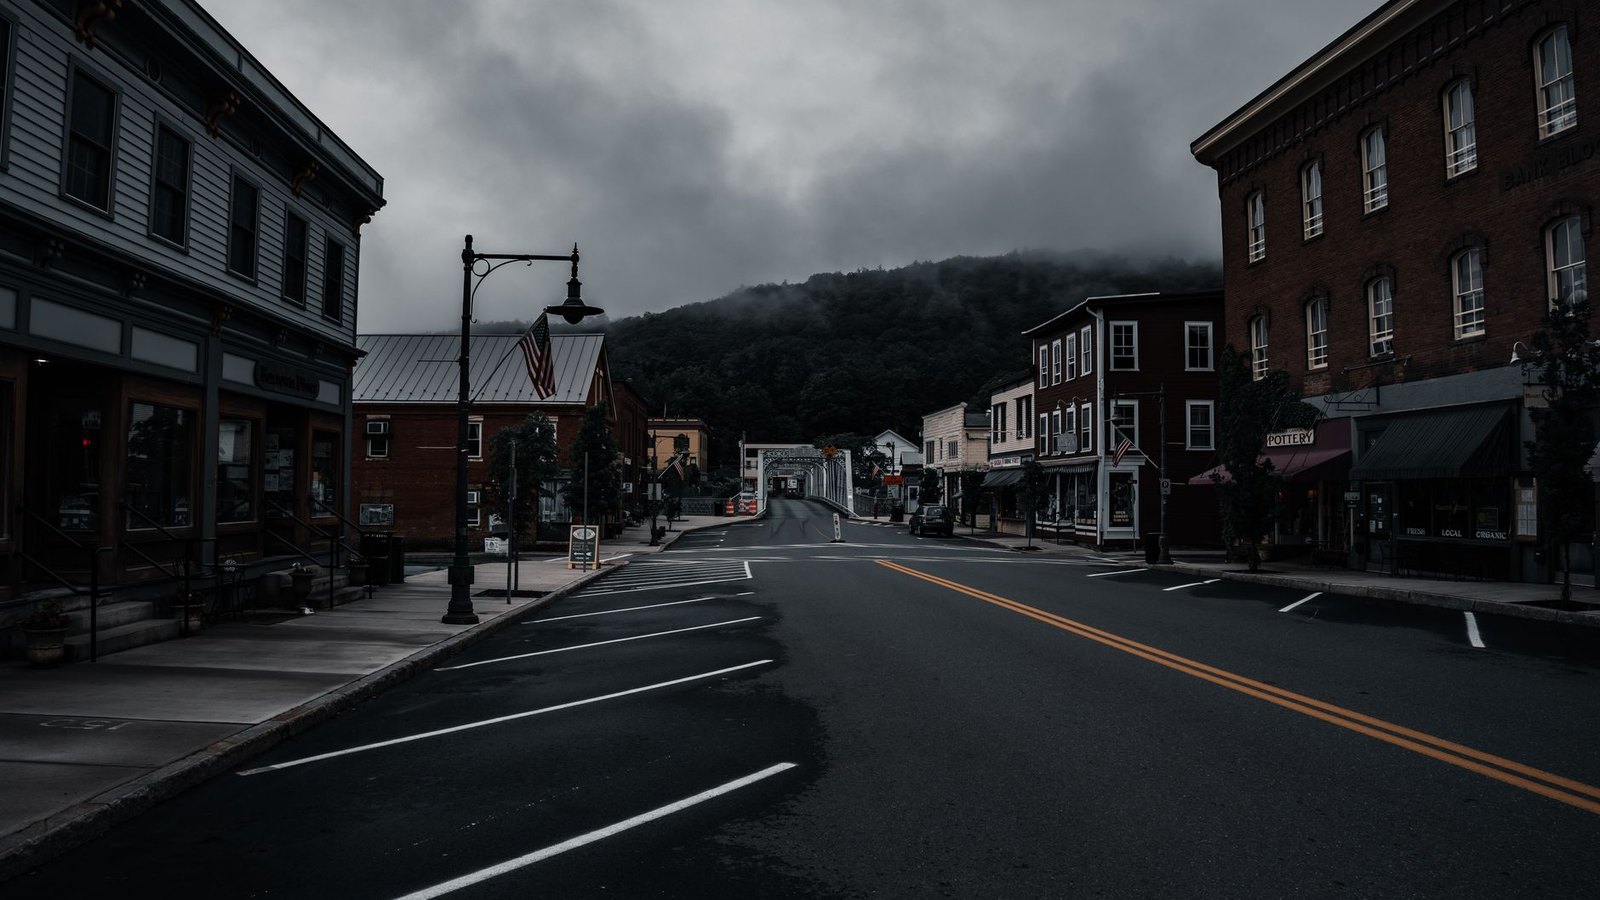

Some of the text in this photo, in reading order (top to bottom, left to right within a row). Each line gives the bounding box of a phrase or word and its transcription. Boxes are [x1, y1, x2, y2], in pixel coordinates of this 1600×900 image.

[1504, 158, 1549, 191] BANK
[1268, 433, 1312, 446] POTTERY
[1406, 527, 1507, 540] FRESH LOCAL ORGANIC
